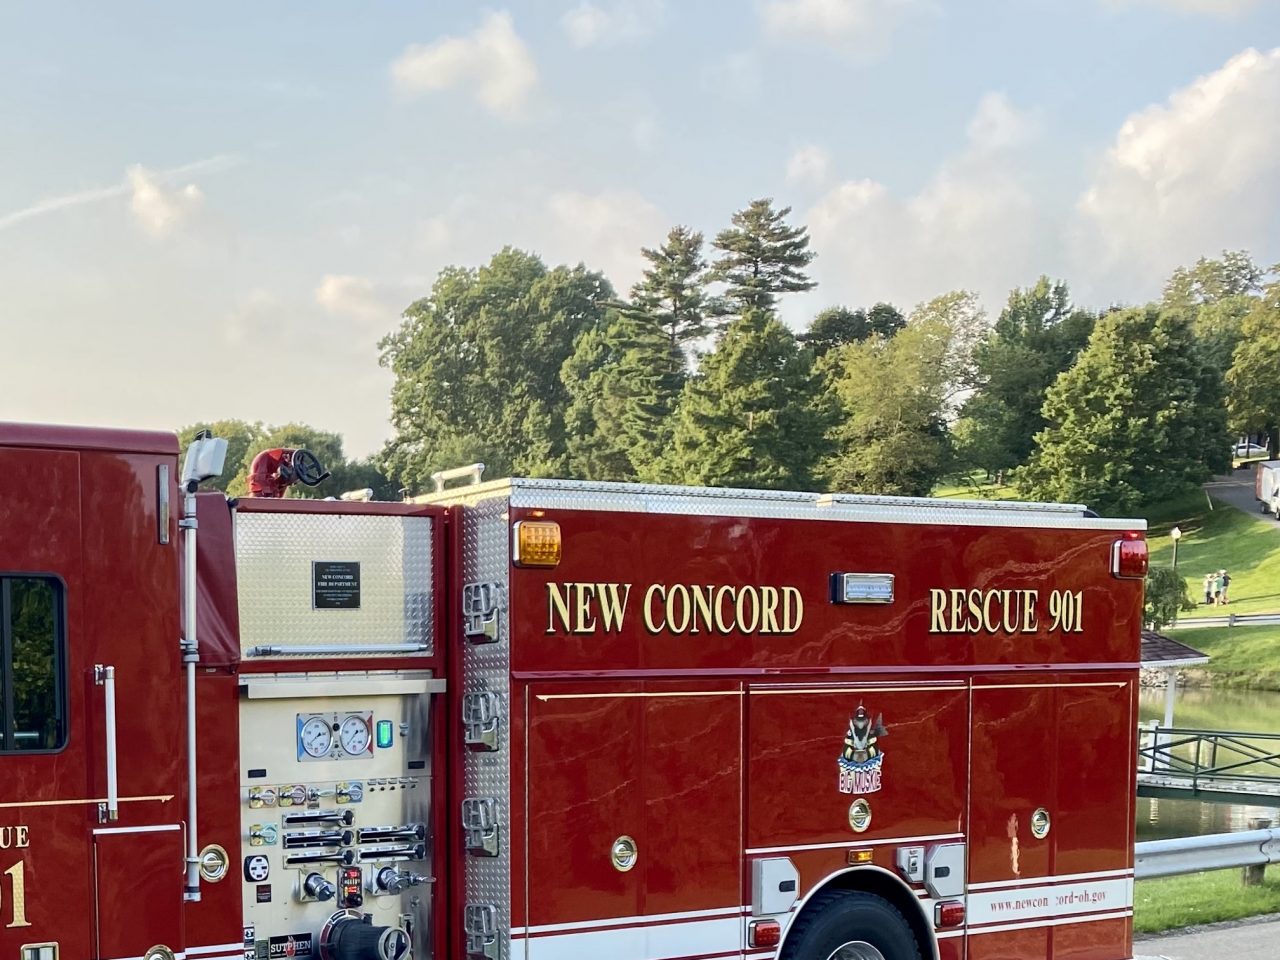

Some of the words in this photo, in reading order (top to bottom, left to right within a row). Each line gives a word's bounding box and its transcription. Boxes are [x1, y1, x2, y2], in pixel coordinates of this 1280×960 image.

[546, 582, 630, 635] NEW
[642, 583, 804, 636] CONCORD
[929, 588, 1039, 633] RESCUE
[1048, 589, 1085, 633] 901
[270, 940, 312, 953] SUTPHEN
